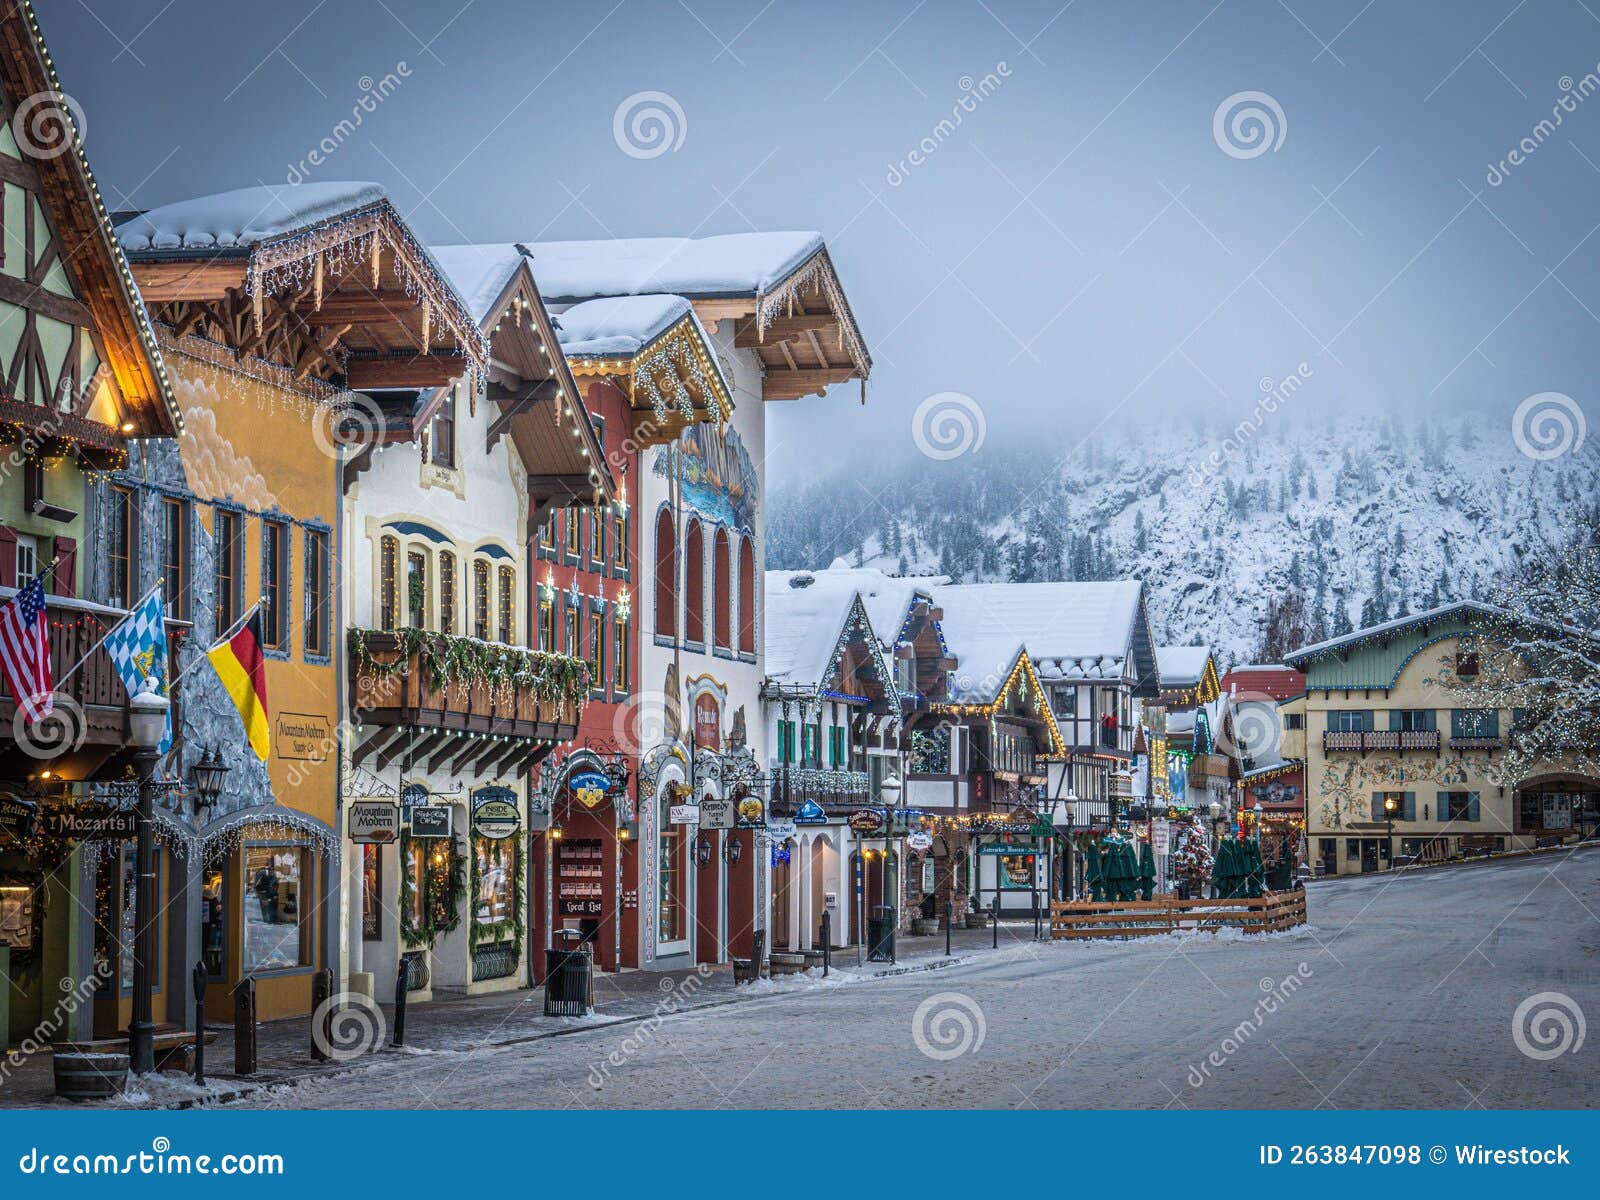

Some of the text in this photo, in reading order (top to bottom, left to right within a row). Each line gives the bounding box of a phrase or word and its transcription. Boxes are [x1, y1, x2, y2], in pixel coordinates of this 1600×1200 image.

[280, 721, 325, 739] Mountain Modern
[353, 805, 393, 817] Mountain
[485, 805, 508, 813] INSIDE
[702, 801, 729, 812] Remedy
[60, 814, 126, 833] Mozart's
[358, 816, 393, 827] Modern
[567, 901, 585, 912] Local
